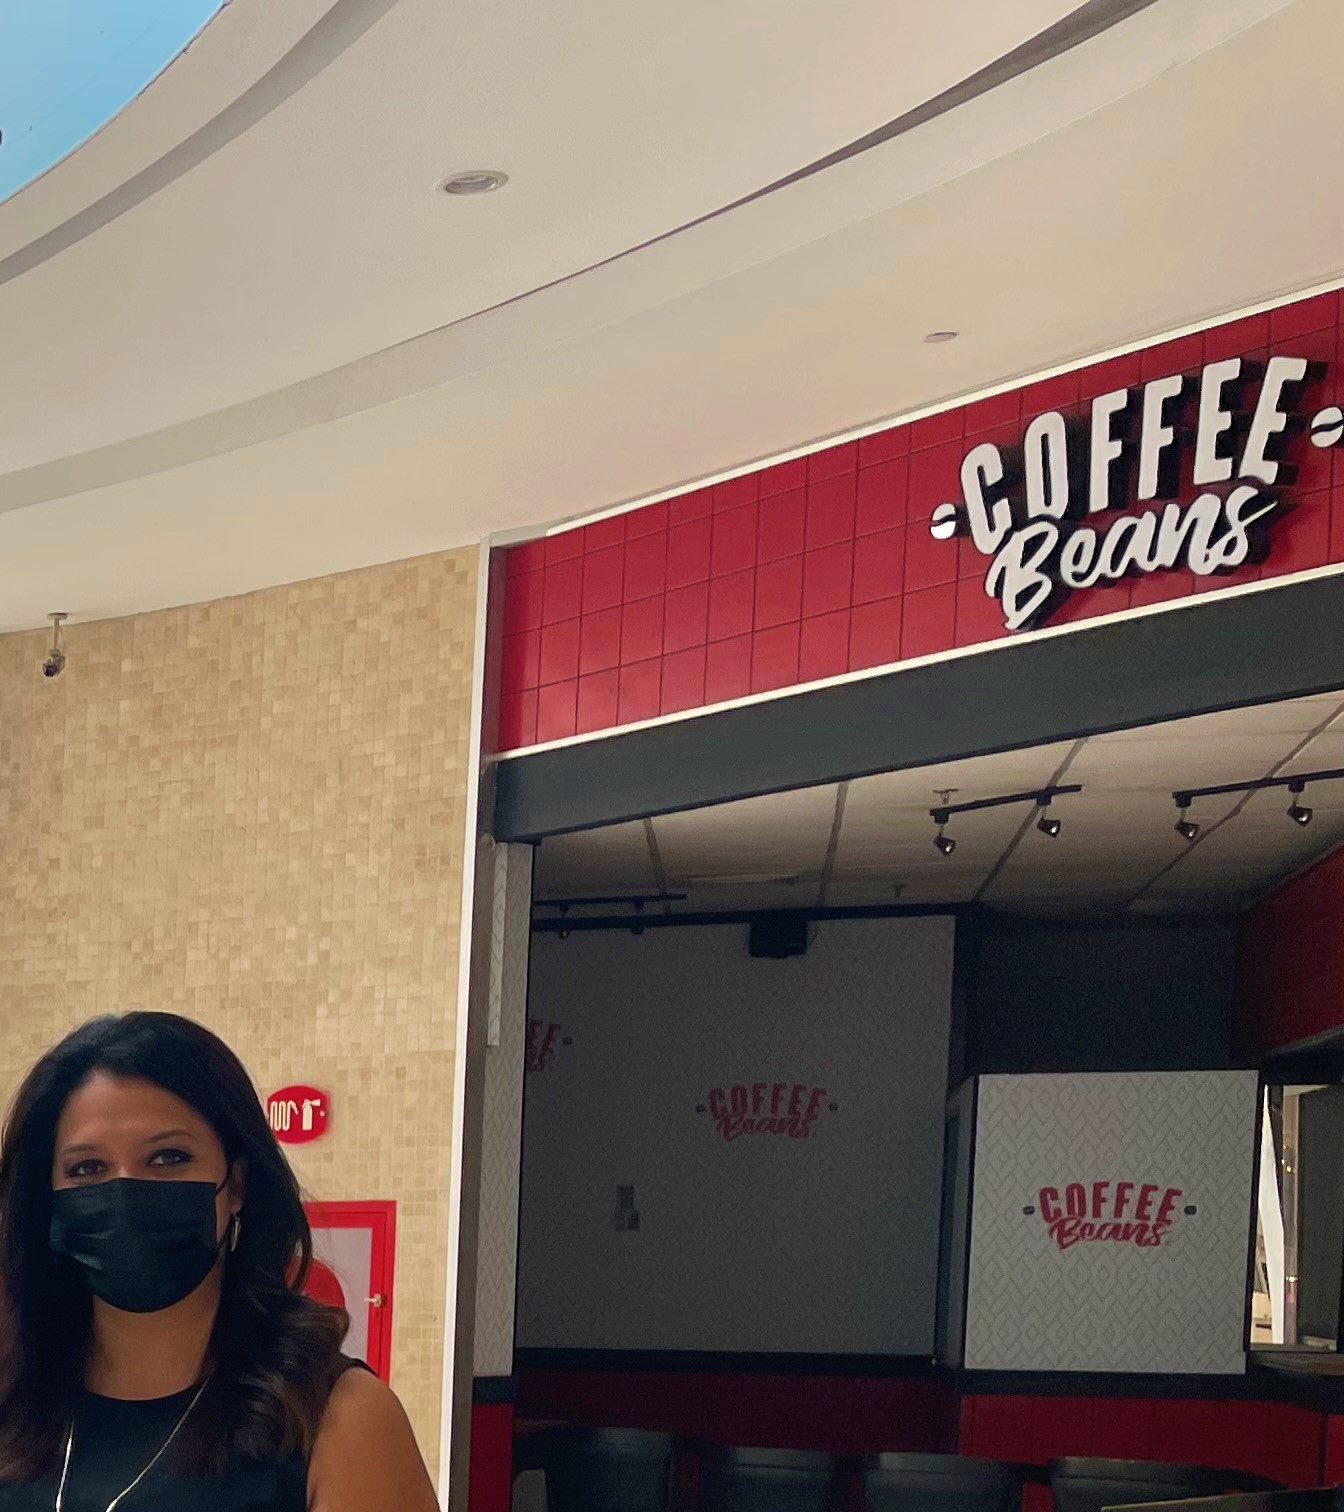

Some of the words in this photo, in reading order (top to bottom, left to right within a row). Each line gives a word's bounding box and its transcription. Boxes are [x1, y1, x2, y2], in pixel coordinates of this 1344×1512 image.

[960, 356, 1308, 555] COFFEE
[984, 486, 1278, 630] Beans
[710, 1082, 827, 1121] COFFEE
[716, 1115, 811, 1142] Beans
[1039, 1181, 1183, 1226] COFFEE
[1048, 1215, 1172, 1250] Beans
